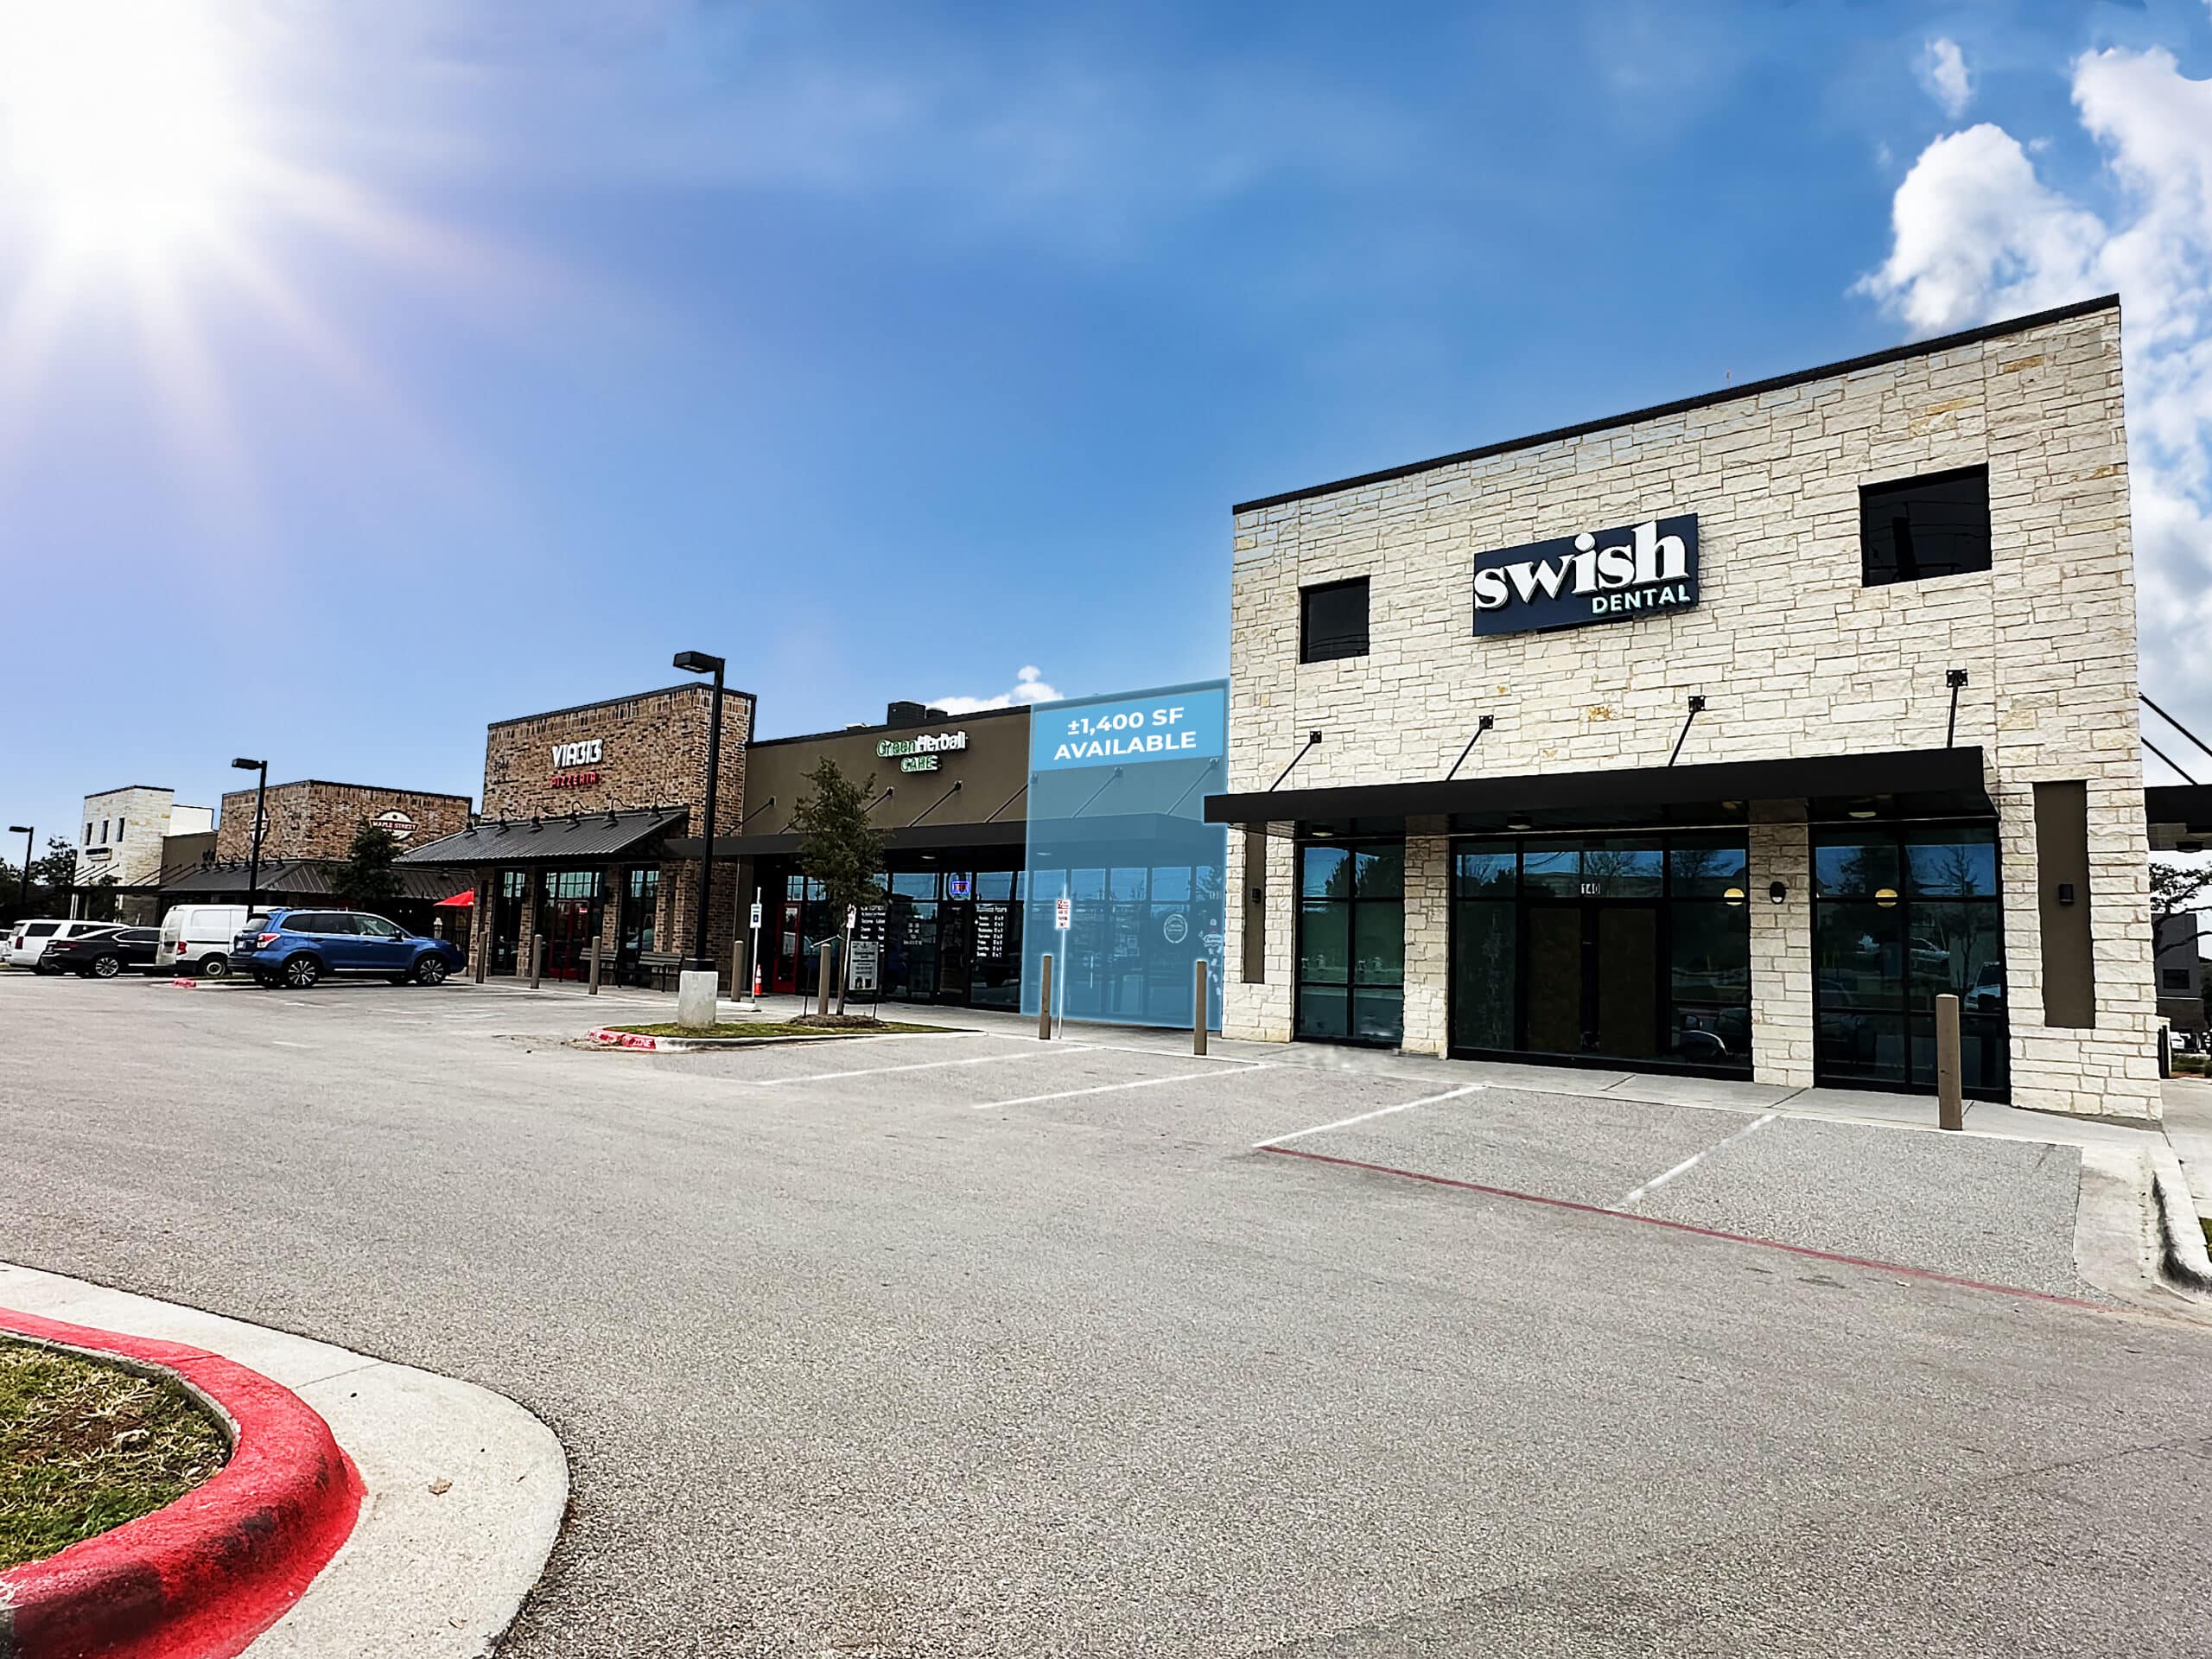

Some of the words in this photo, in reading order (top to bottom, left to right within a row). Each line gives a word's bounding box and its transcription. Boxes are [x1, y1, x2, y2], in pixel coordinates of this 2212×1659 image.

[1474, 520, 1689, 609] swish
[1592, 584, 1691, 614] DENTAL
[900, 755, 938, 772] CARE
[550, 772, 597, 787] PIZZERIA
